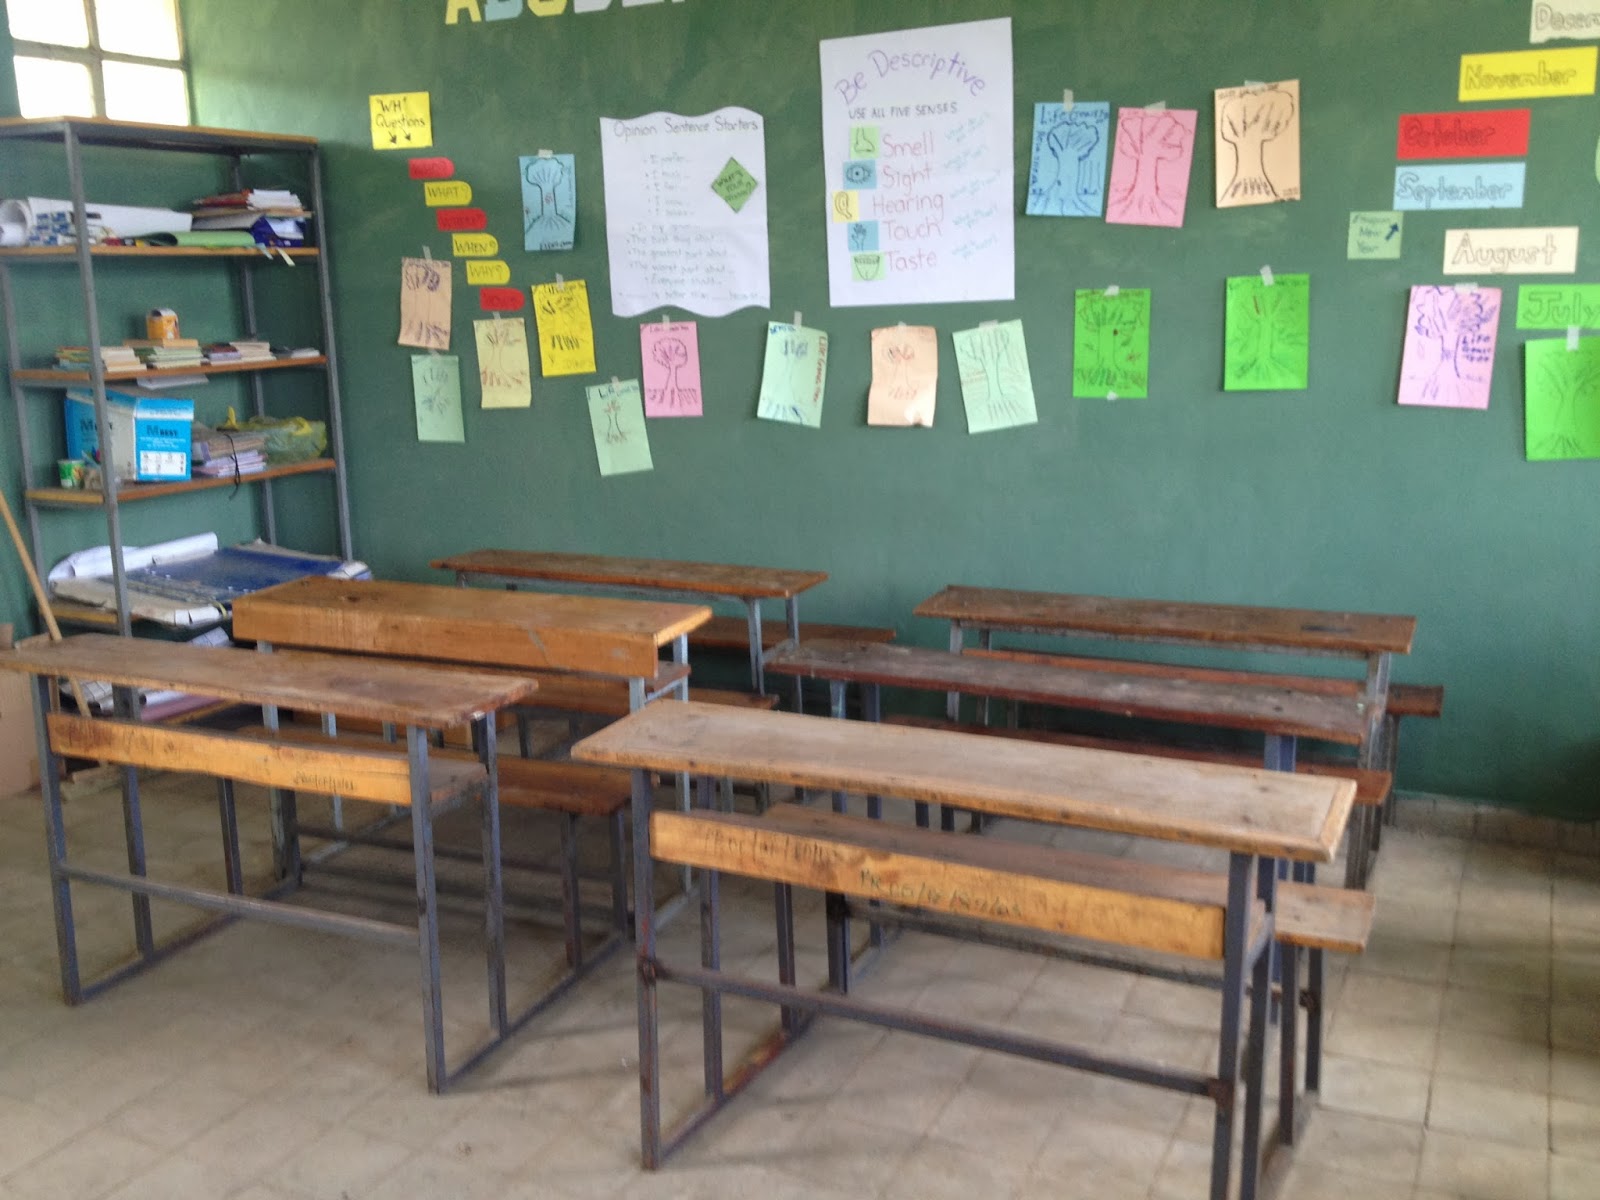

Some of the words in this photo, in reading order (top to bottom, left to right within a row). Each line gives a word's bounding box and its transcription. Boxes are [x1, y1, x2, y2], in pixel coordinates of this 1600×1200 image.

[834, 71, 867, 104] Be
[867, 49, 986, 96] Descriptive
[1464, 59, 1577, 90] November
[375, 113, 426, 128] Questions
[849, 106, 867, 120] USE
[871, 106, 886, 119] ALL
[890, 105, 912, 118] FIVE
[915, 101, 958, 117] SENSES
[613, 120, 658, 142] Opinion
[664, 117, 710, 134] Sentence
[714, 115, 759, 132] Starters
[1404, 117, 1495, 147] October
[881, 130, 934, 158] Smell
[882, 162, 933, 196] Sight
[1396, 171, 1513, 209] September
[872, 193, 945, 222] Hearing
[882, 215, 942, 241] Touch
[454, 240, 496, 253] WHEN?
[884, 248, 937, 271] Taste
[1452, 232, 1556, 273] August
